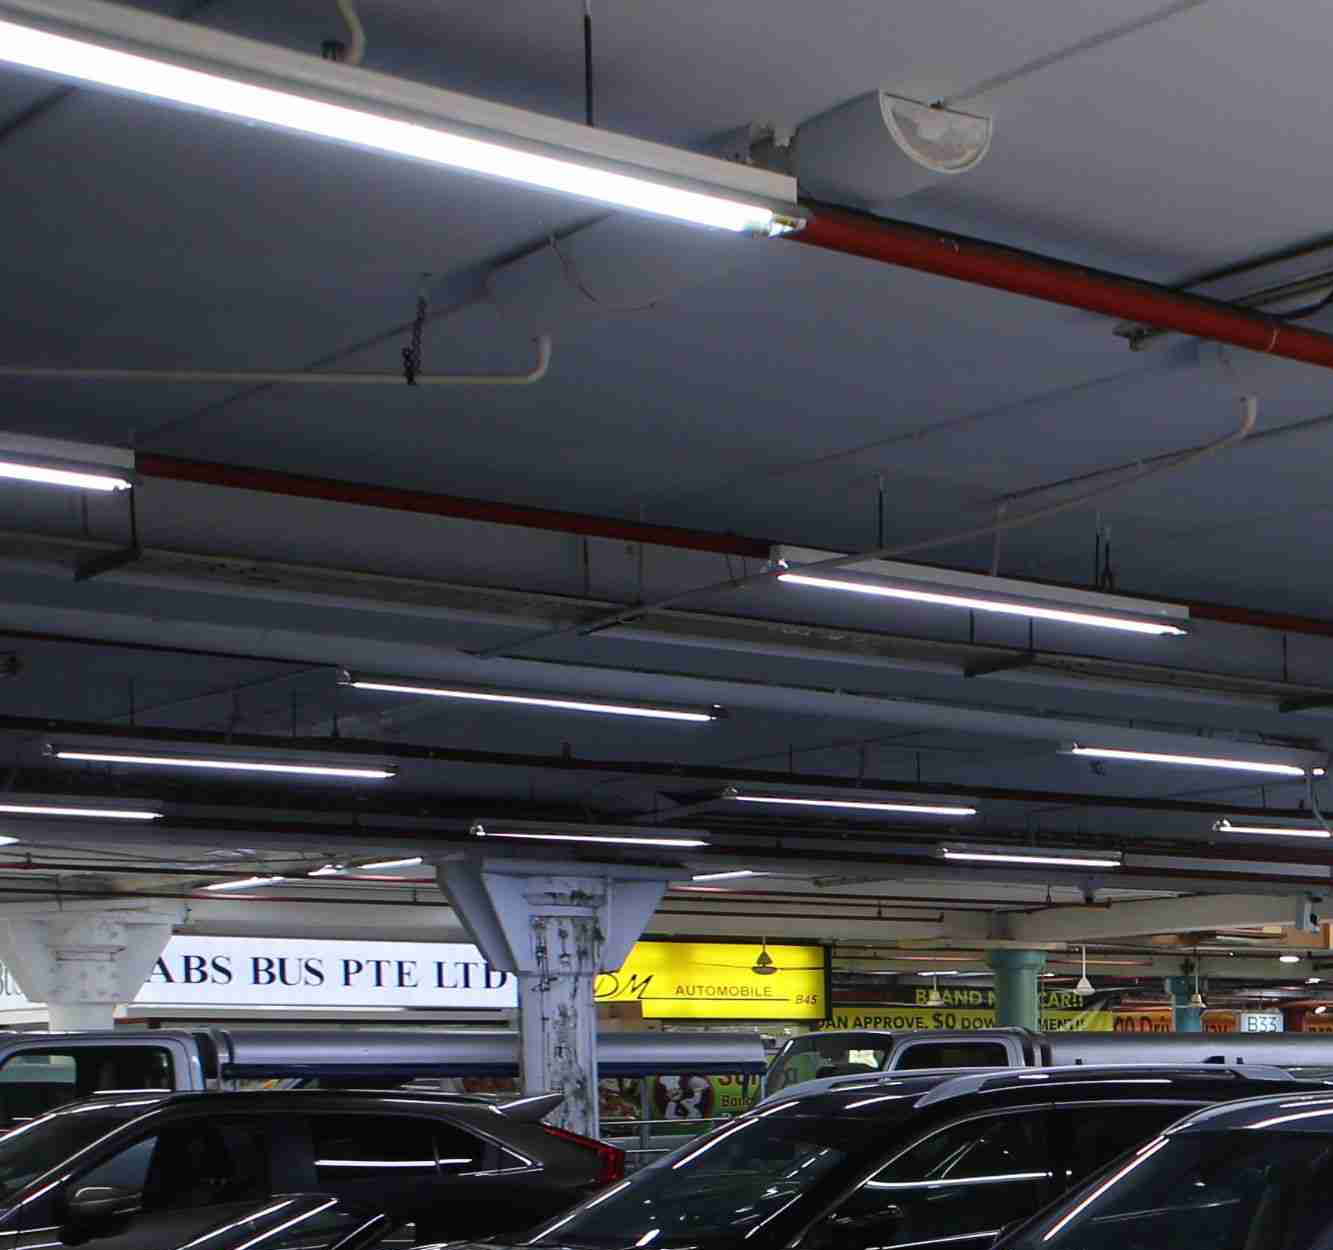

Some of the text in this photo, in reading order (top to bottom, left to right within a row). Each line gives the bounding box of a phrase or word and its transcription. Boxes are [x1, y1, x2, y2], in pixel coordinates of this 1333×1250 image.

[145, 955, 508, 989] ABS BUS PTE LTD
[674, 984, 773, 998] AUTOMOBILE
[795, 994, 818, 1005] B45
[915, 988, 987, 1006] BAND
[932, 1012, 956, 1030] $0
